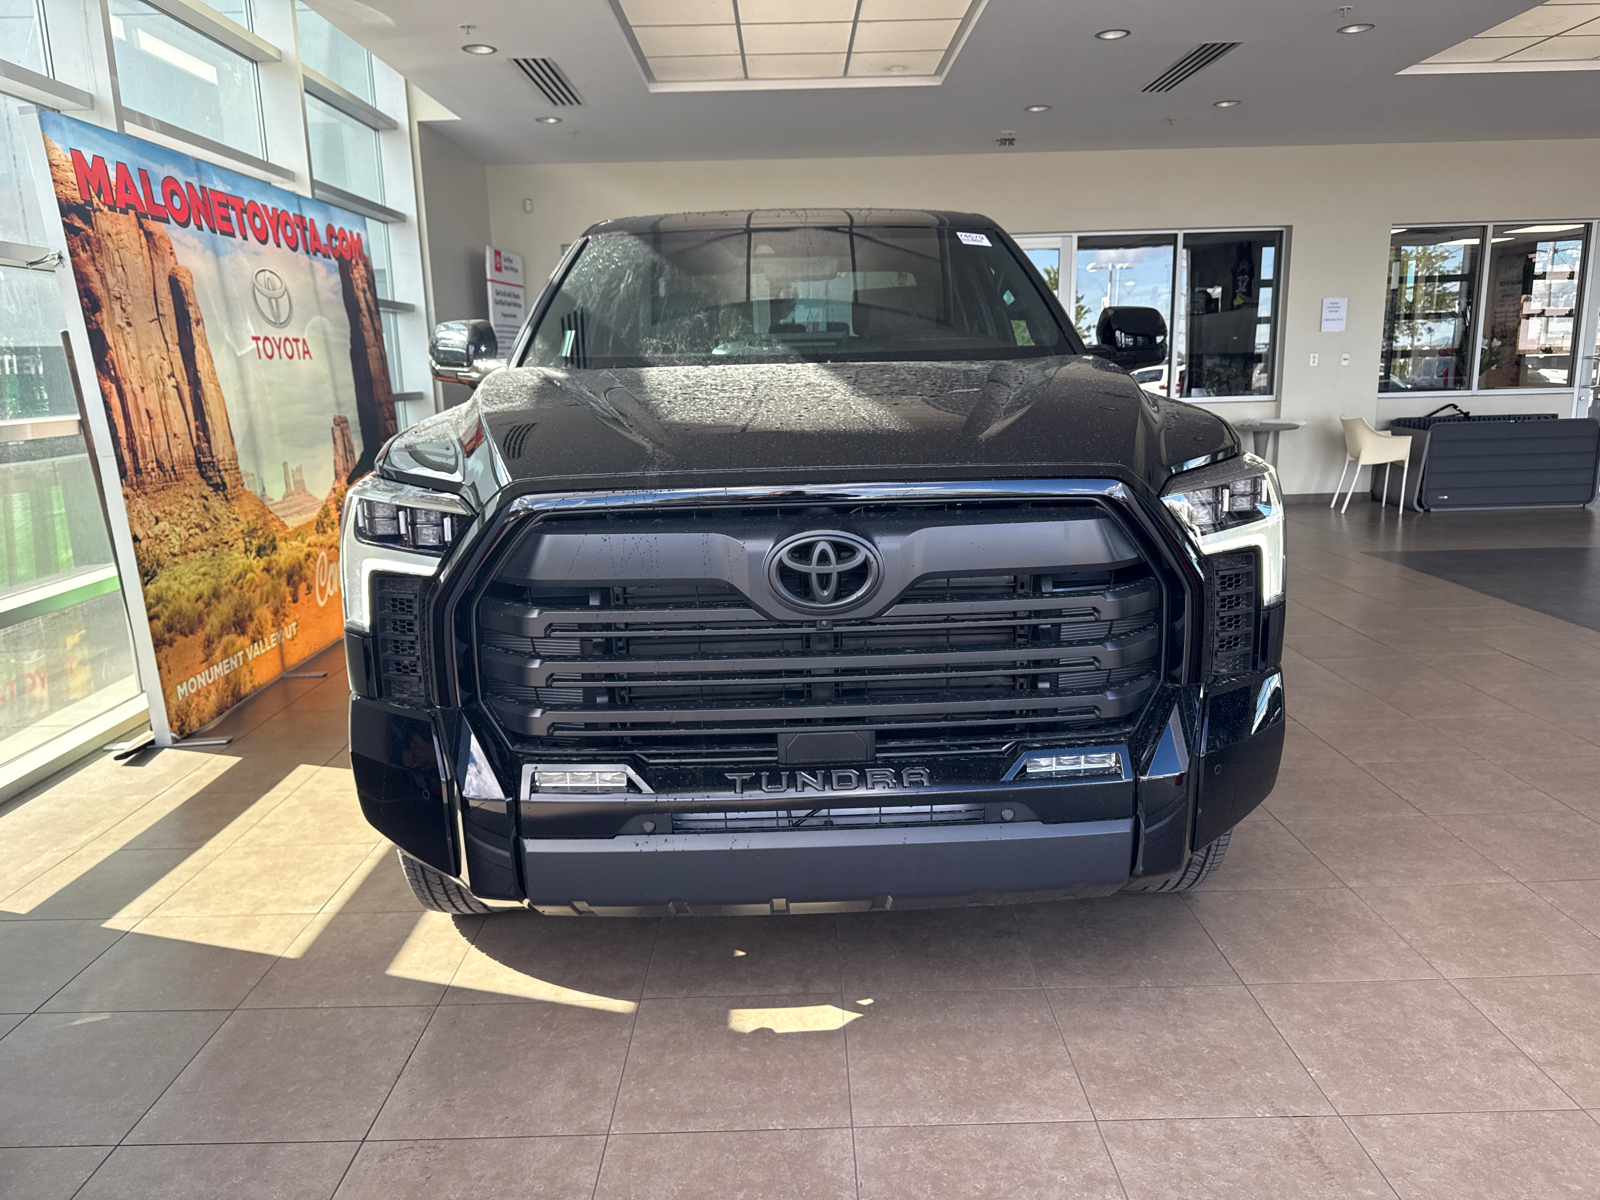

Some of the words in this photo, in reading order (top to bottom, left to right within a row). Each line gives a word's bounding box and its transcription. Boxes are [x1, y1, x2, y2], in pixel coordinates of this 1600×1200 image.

[69, 147, 369, 263] MALONETOYOTA.COM
[251, 335, 312, 361] TOYOTA
[176, 650, 245, 701] MONUMENT
[246, 629, 284, 659] VALLEY,
[284, 620, 298, 642] UT
[724, 766, 932, 794] TUNDRA
